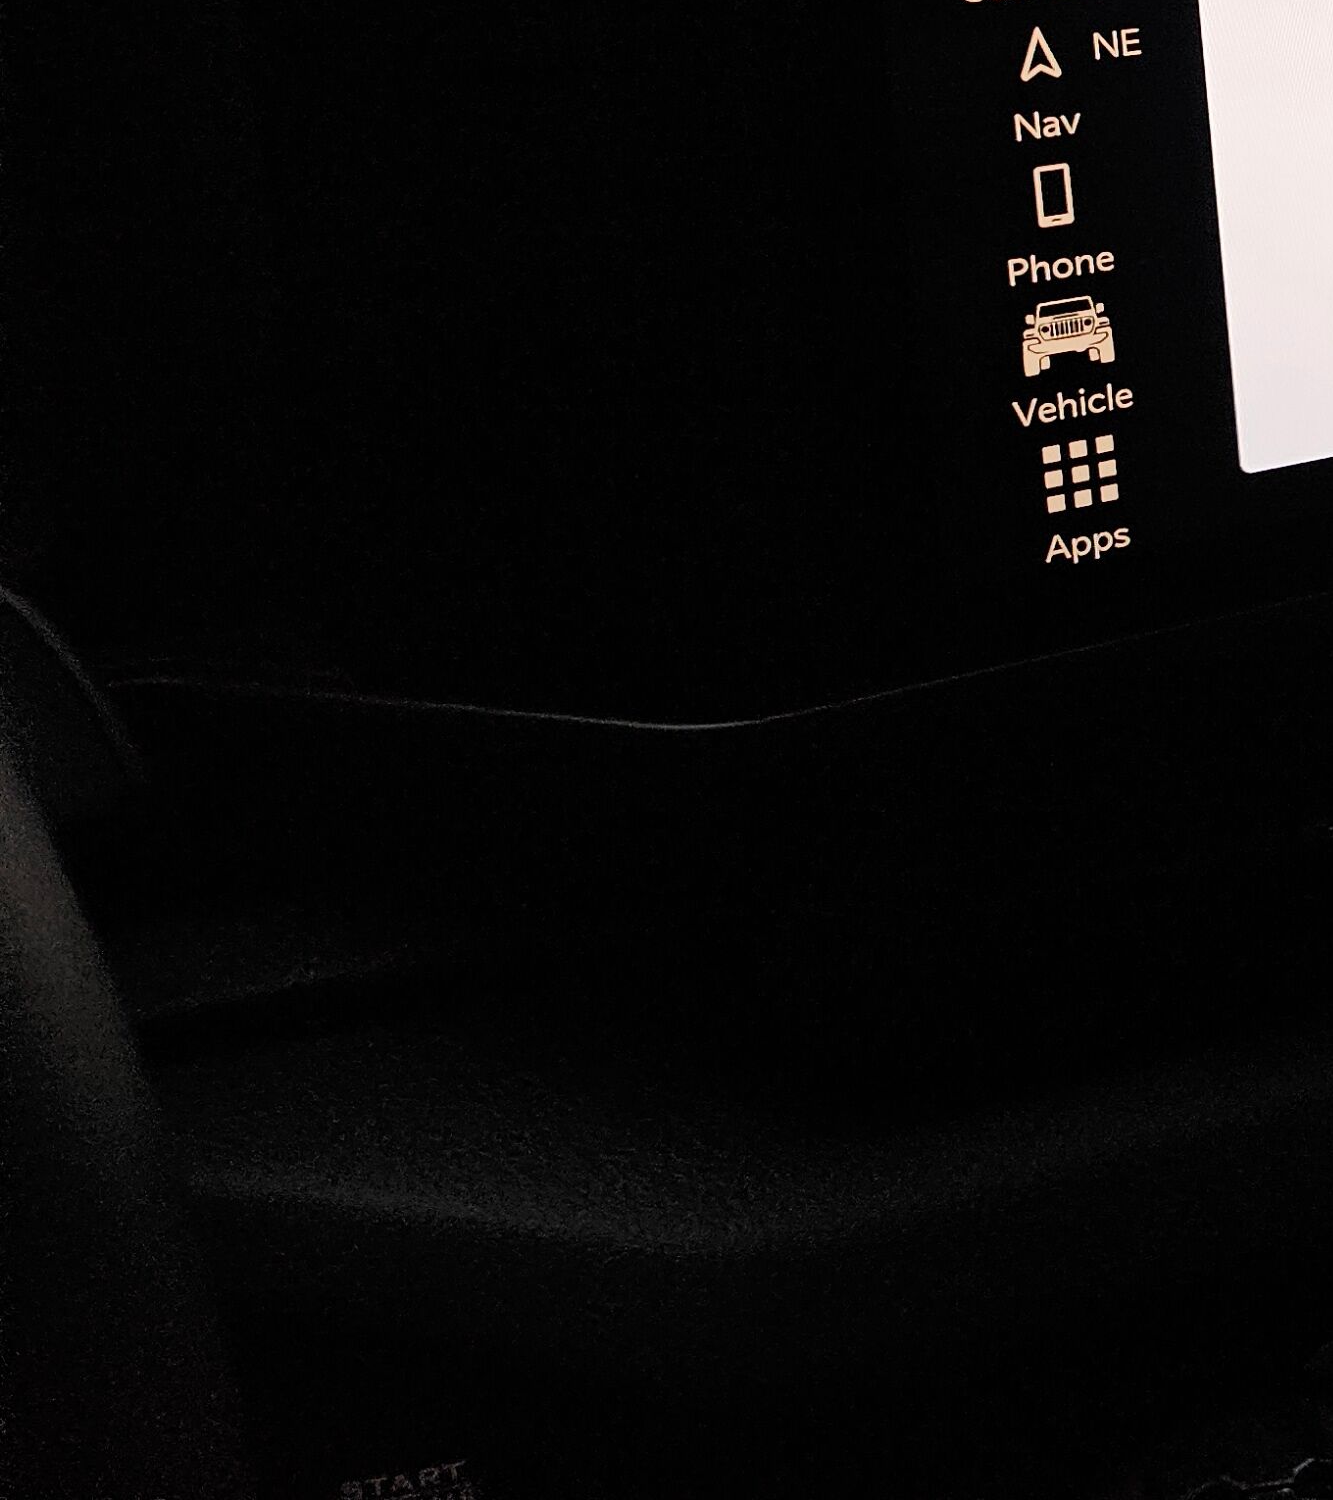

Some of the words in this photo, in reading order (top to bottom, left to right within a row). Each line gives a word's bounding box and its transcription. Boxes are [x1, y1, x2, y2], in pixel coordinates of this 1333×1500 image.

[1093, 28, 1142, 60] NE
[1014, 111, 1081, 142] Nav
[1008, 252, 1114, 286] Phone
[1012, 383, 1133, 427] Vehicle
[1046, 528, 1130, 564] Apps
